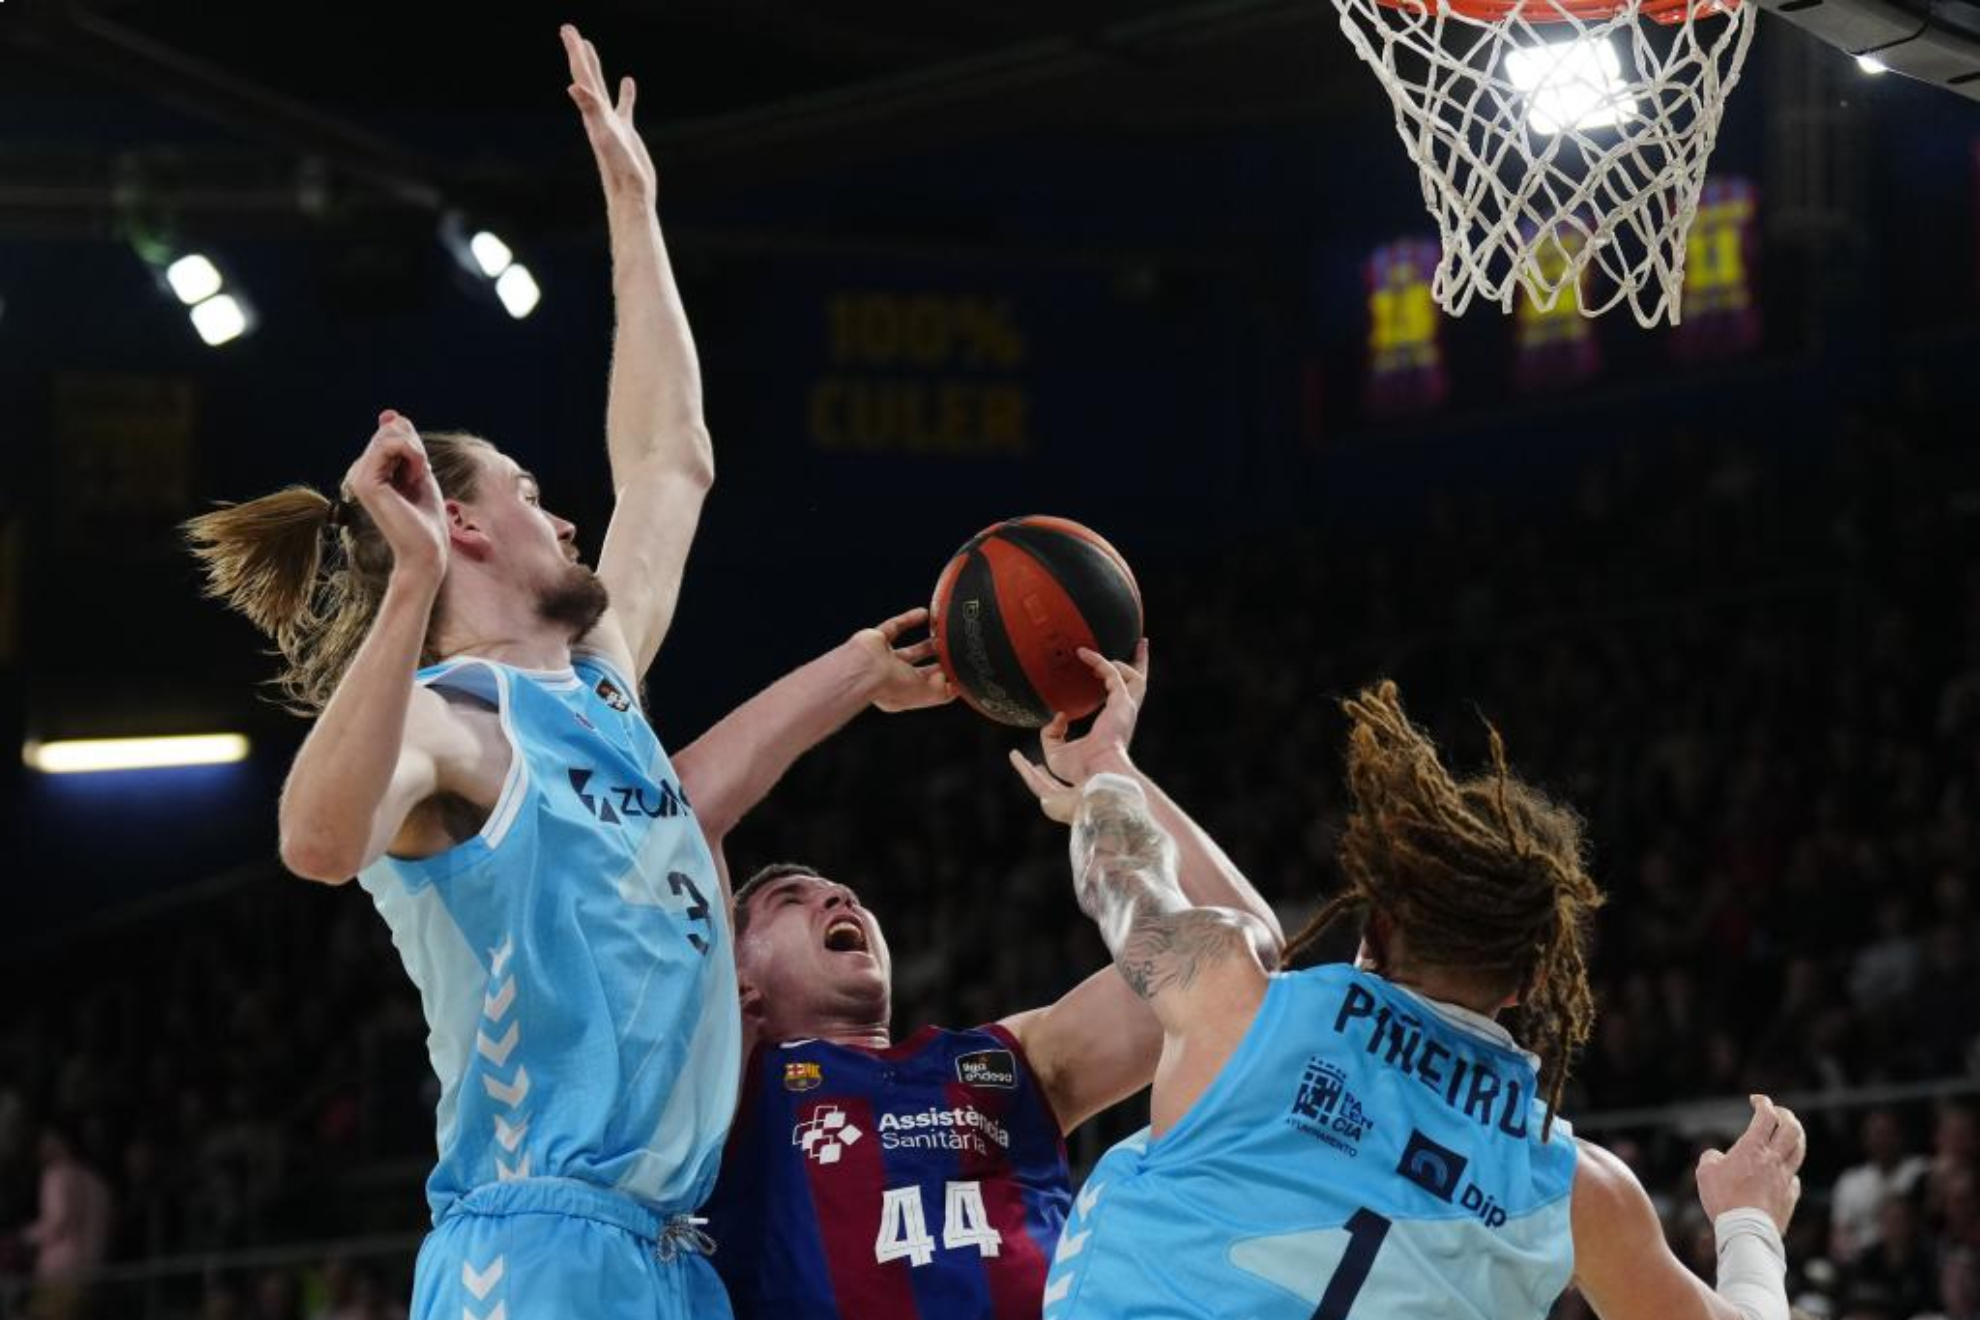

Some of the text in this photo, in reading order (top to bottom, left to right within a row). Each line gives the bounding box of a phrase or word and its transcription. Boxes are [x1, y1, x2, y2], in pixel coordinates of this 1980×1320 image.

[828, 295, 1023, 365] 100%
[808, 382, 1030, 453] CULER
[667, 871, 713, 956] 3
[965, 1071, 1012, 1083] endesa
[878, 1105, 1010, 1148] Assistència
[881, 1129, 987, 1156] Sanitària
[874, 1181, 1002, 1267] 44
[1459, 1184, 1508, 1229] Dip
[1310, 1207, 1392, 1320] 1
